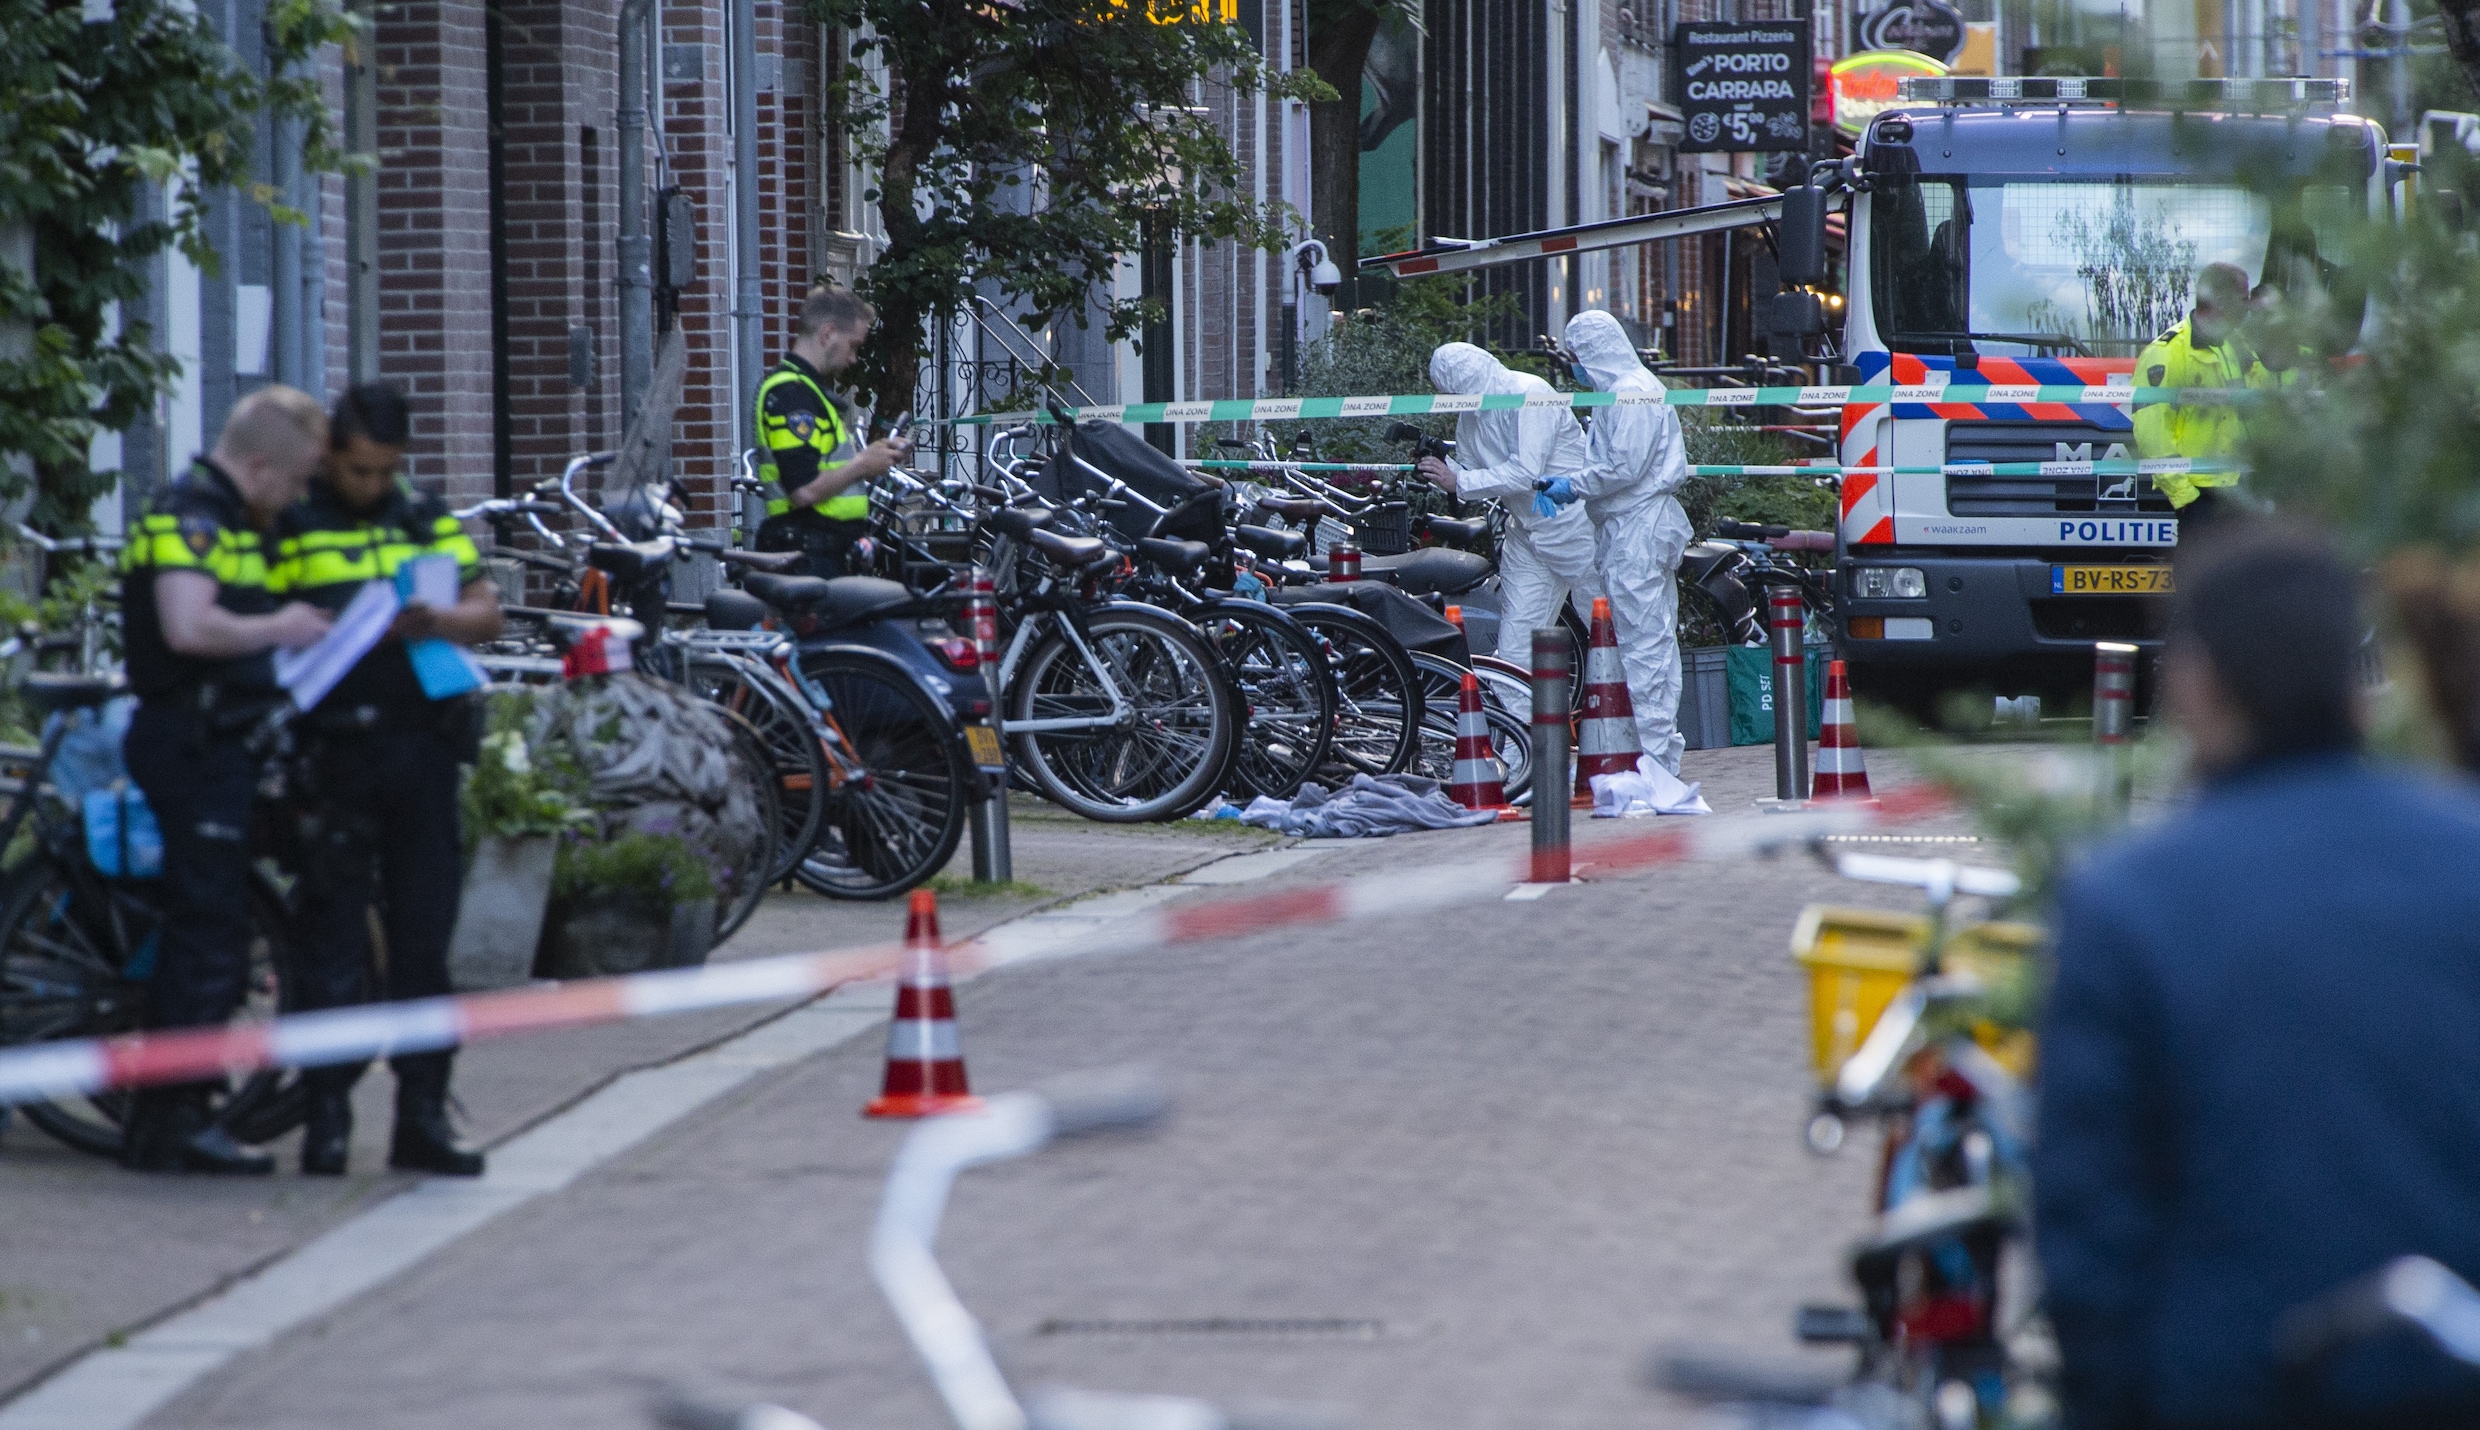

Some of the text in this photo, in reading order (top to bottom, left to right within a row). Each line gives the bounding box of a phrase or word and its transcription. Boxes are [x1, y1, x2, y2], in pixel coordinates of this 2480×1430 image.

[1689, 29, 1794, 44] Restaurant Pizzeria
[1715, 53, 1790, 73] PORTO
[1688, 80, 1795, 99] CARRARA
[1801, 391, 1847, 400] DNA ZONE
[1895, 389, 1941, 398] DNA ZONE
[1990, 389, 2036, 398] DNA ZONE
[2084, 389, 2131, 398] DNA ZONE
[1709, 394, 1754, 403] DNA ZONE
[1254, 404, 1298, 414] DNA ZONE
[1343, 402, 1388, 411] DNA ZONE
[1454, 401, 1480, 409] ZONE
[1165, 407, 1210, 417] DNA ZONE
[2043, 466, 2091, 475] DNA ZONE
[1931, 525, 1987, 534] waakzaam
[2060, 522, 2173, 541] POLITIE
[1760, 674, 1773, 710] PD SET
